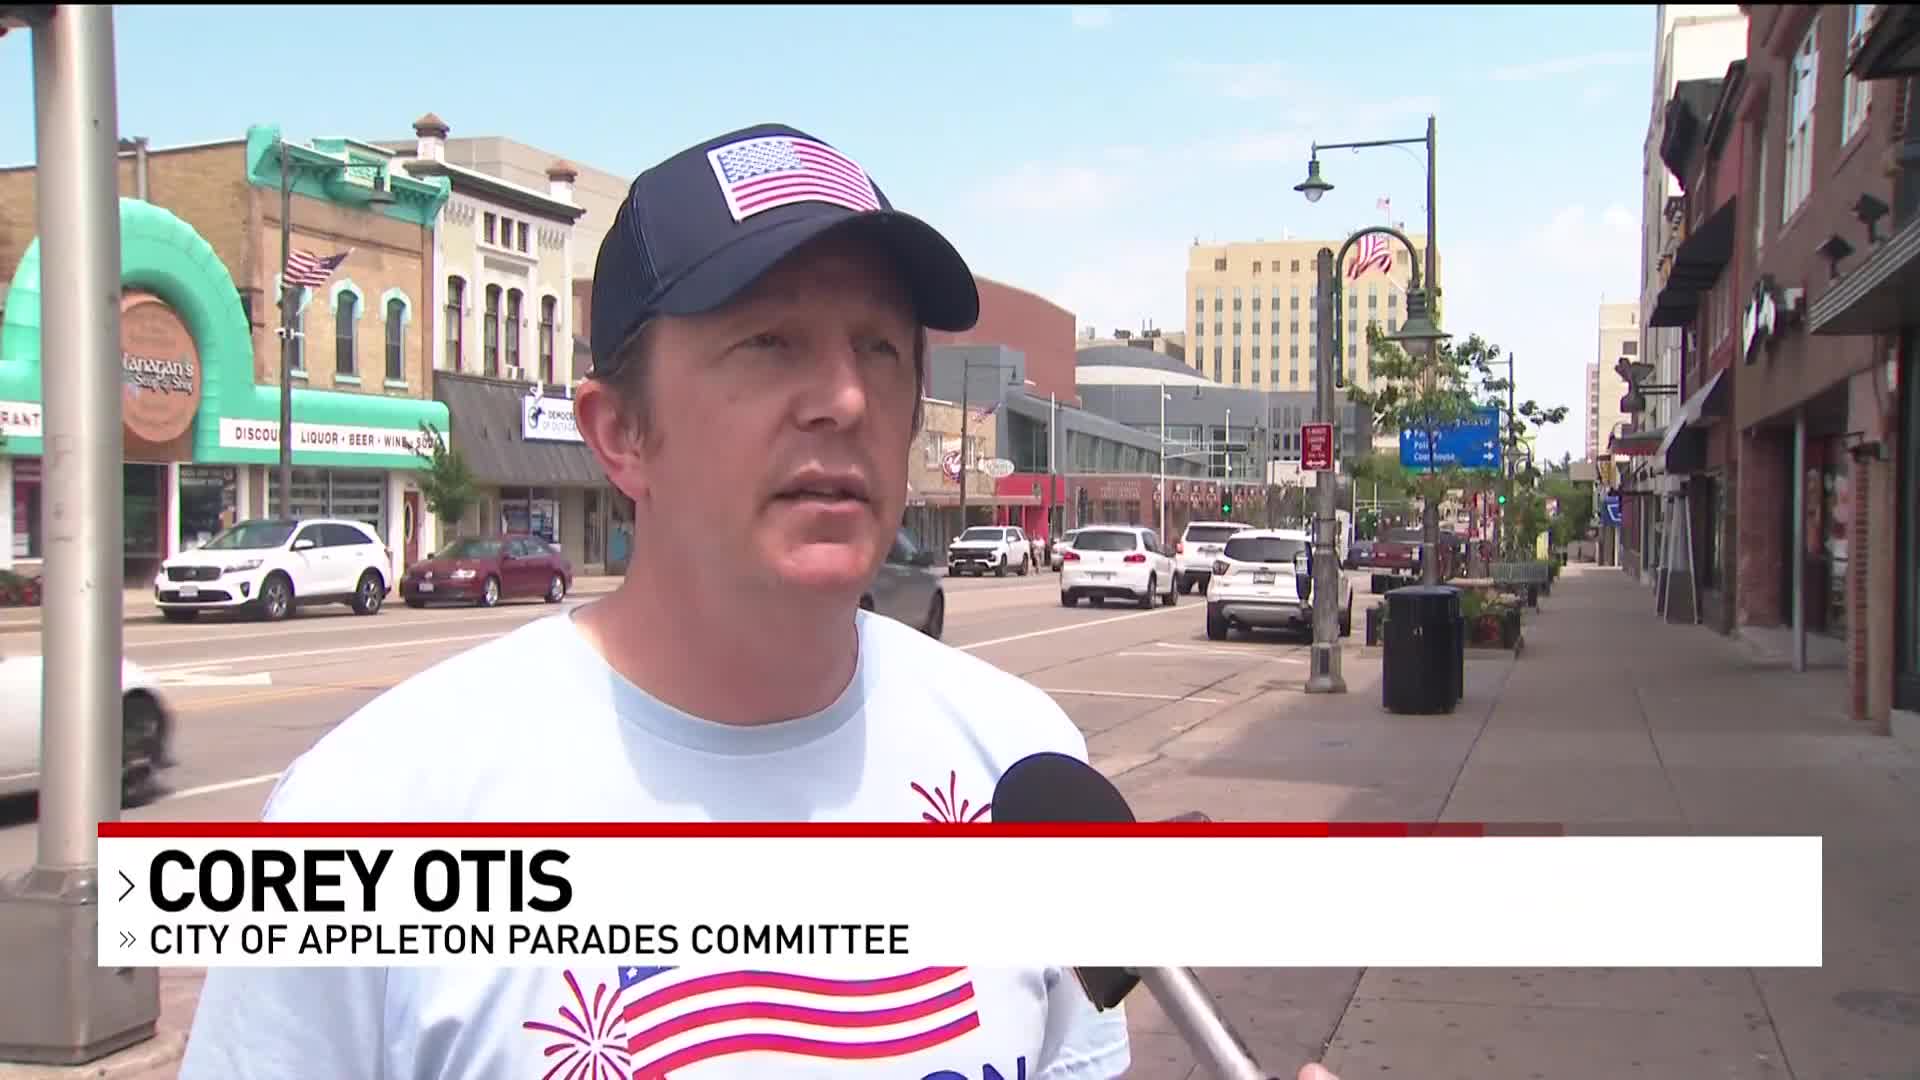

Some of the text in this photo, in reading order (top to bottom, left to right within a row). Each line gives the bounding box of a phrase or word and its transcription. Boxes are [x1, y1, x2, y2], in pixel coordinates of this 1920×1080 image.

[122, 352, 194, 378] lanagan's
[235, 426, 281, 442] DISCOU
[301, 431, 338, 444] LIQUOR
[349, 433, 374, 446] BEER
[384, 436, 407, 448] WINE
